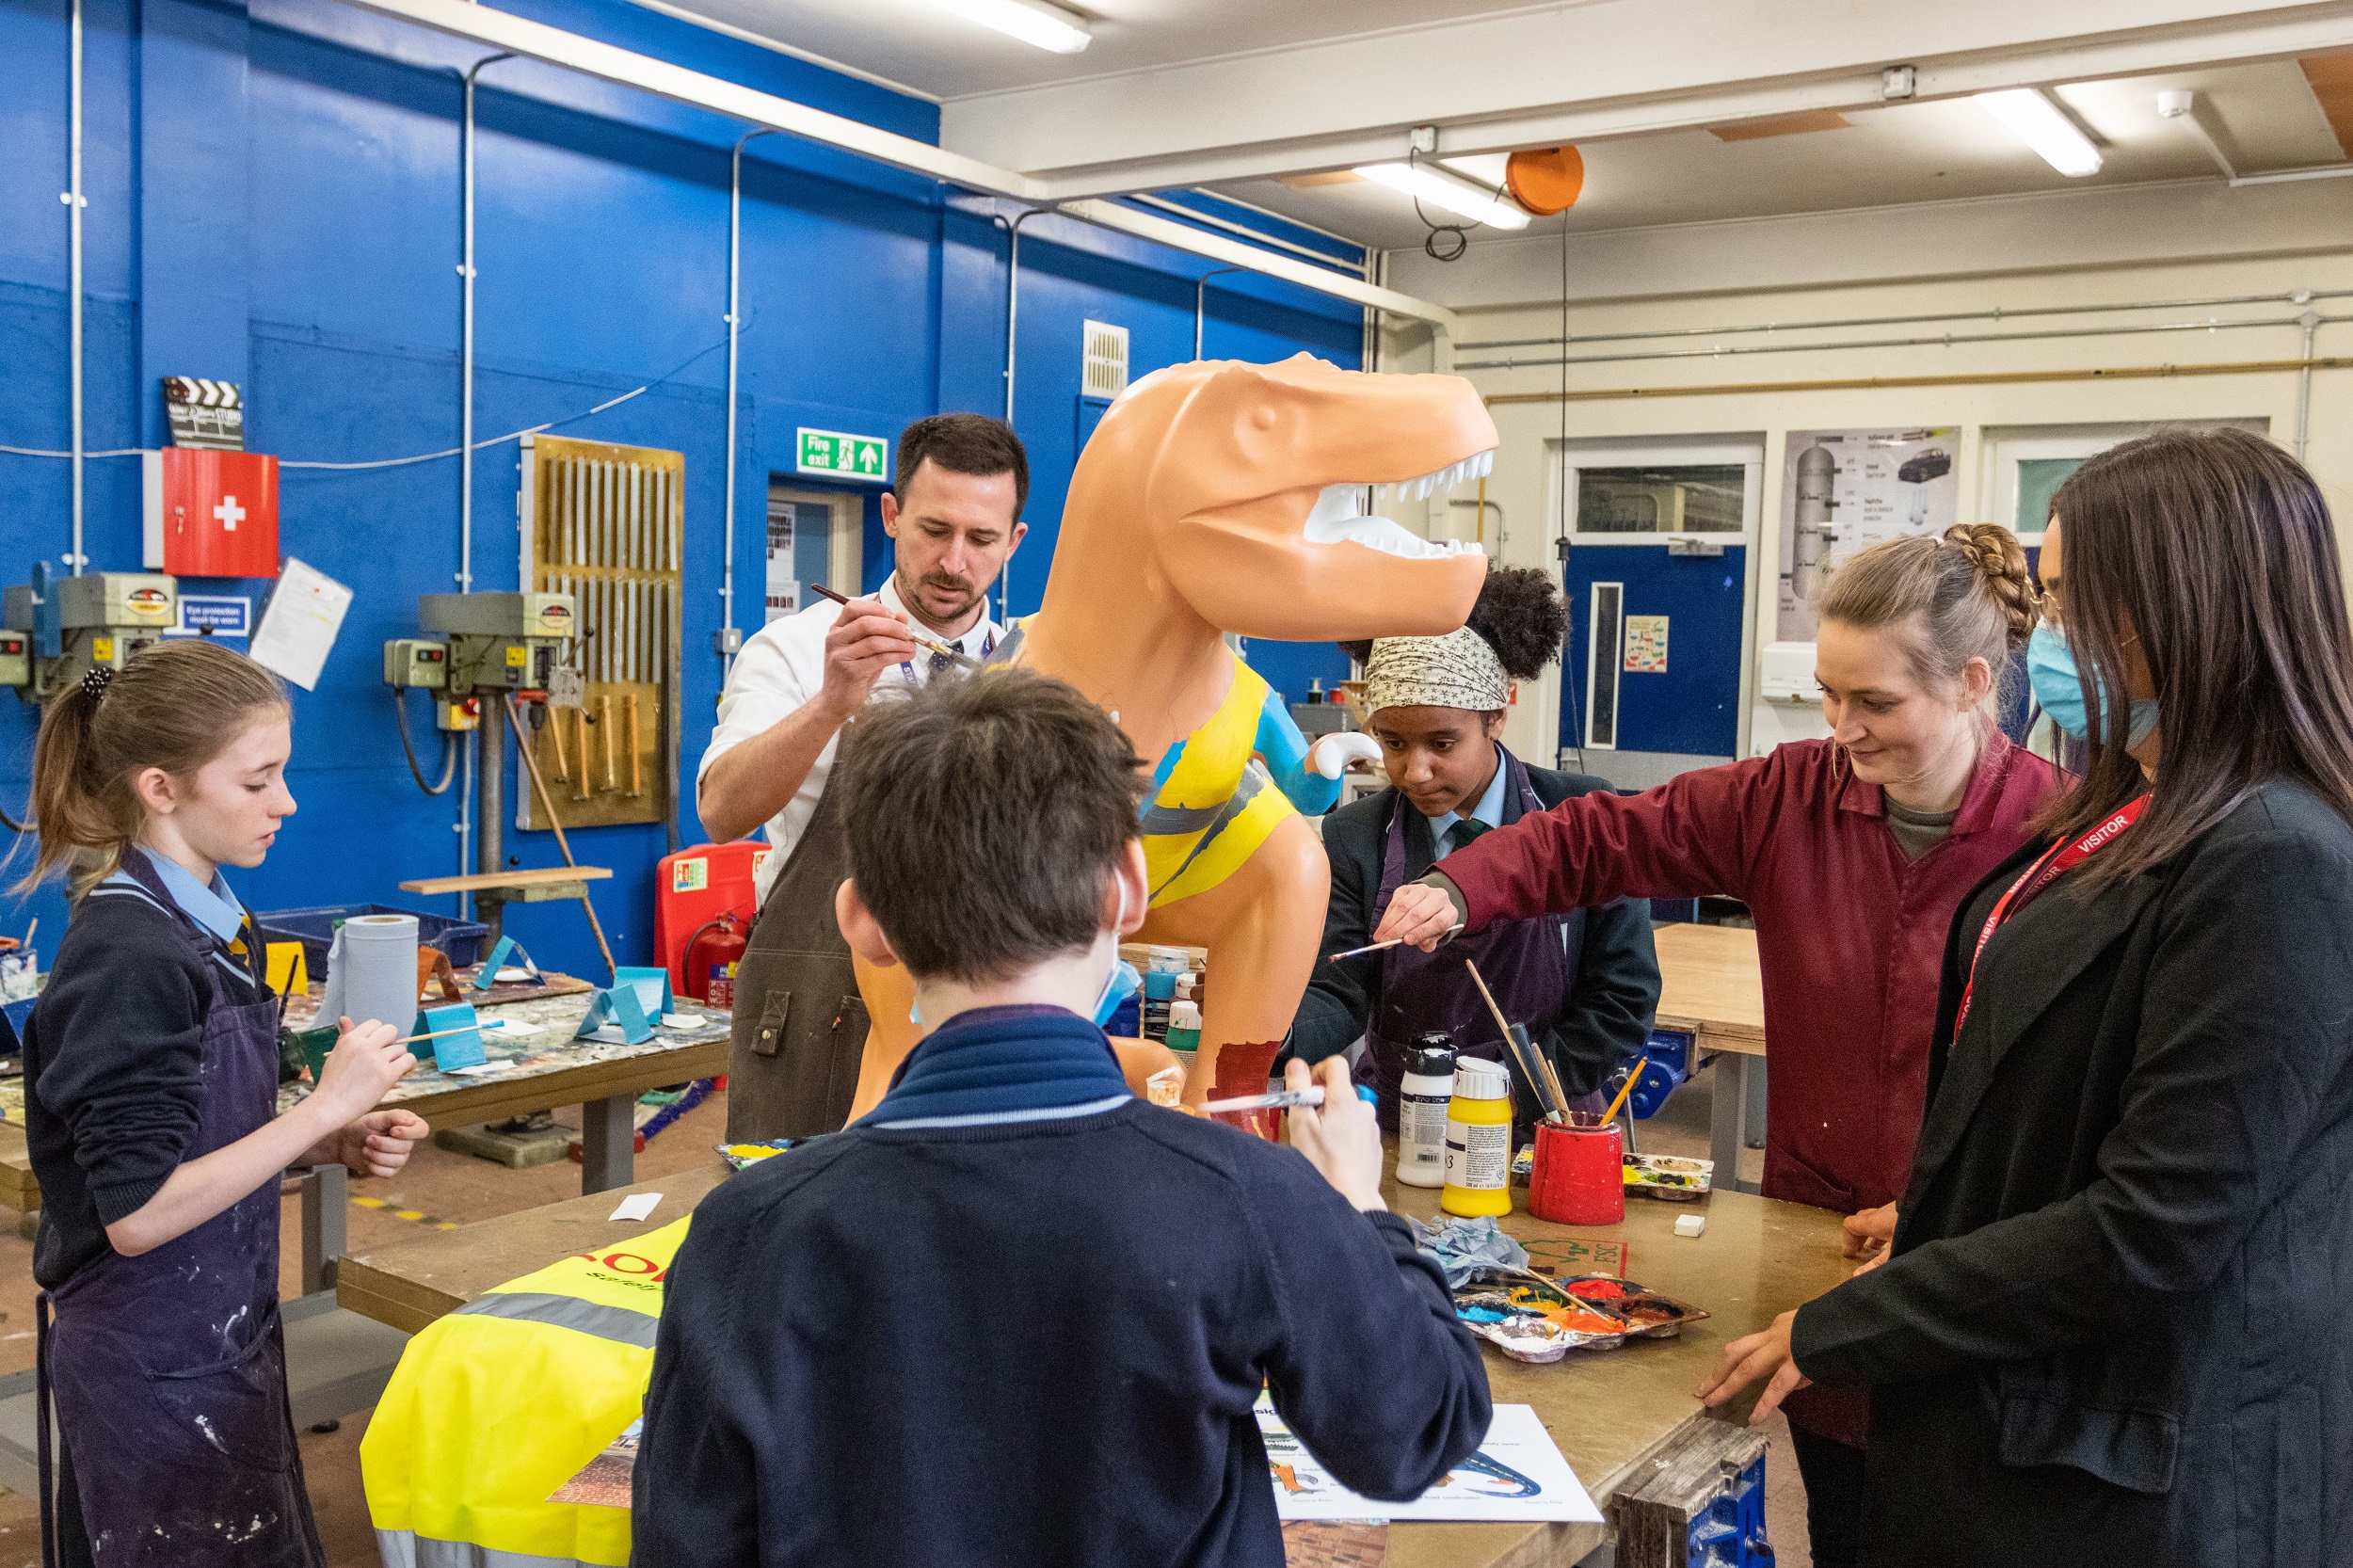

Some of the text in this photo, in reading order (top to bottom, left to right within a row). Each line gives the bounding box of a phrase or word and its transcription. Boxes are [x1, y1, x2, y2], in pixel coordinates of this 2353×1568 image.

[808, 435, 830, 453] Fire
[808, 452, 829, 467] exit
[186, 605, 239, 616] Eye protection
[2077, 815, 2128, 853] VISITOR
[1593, 1243, 1618, 1264] FSC
